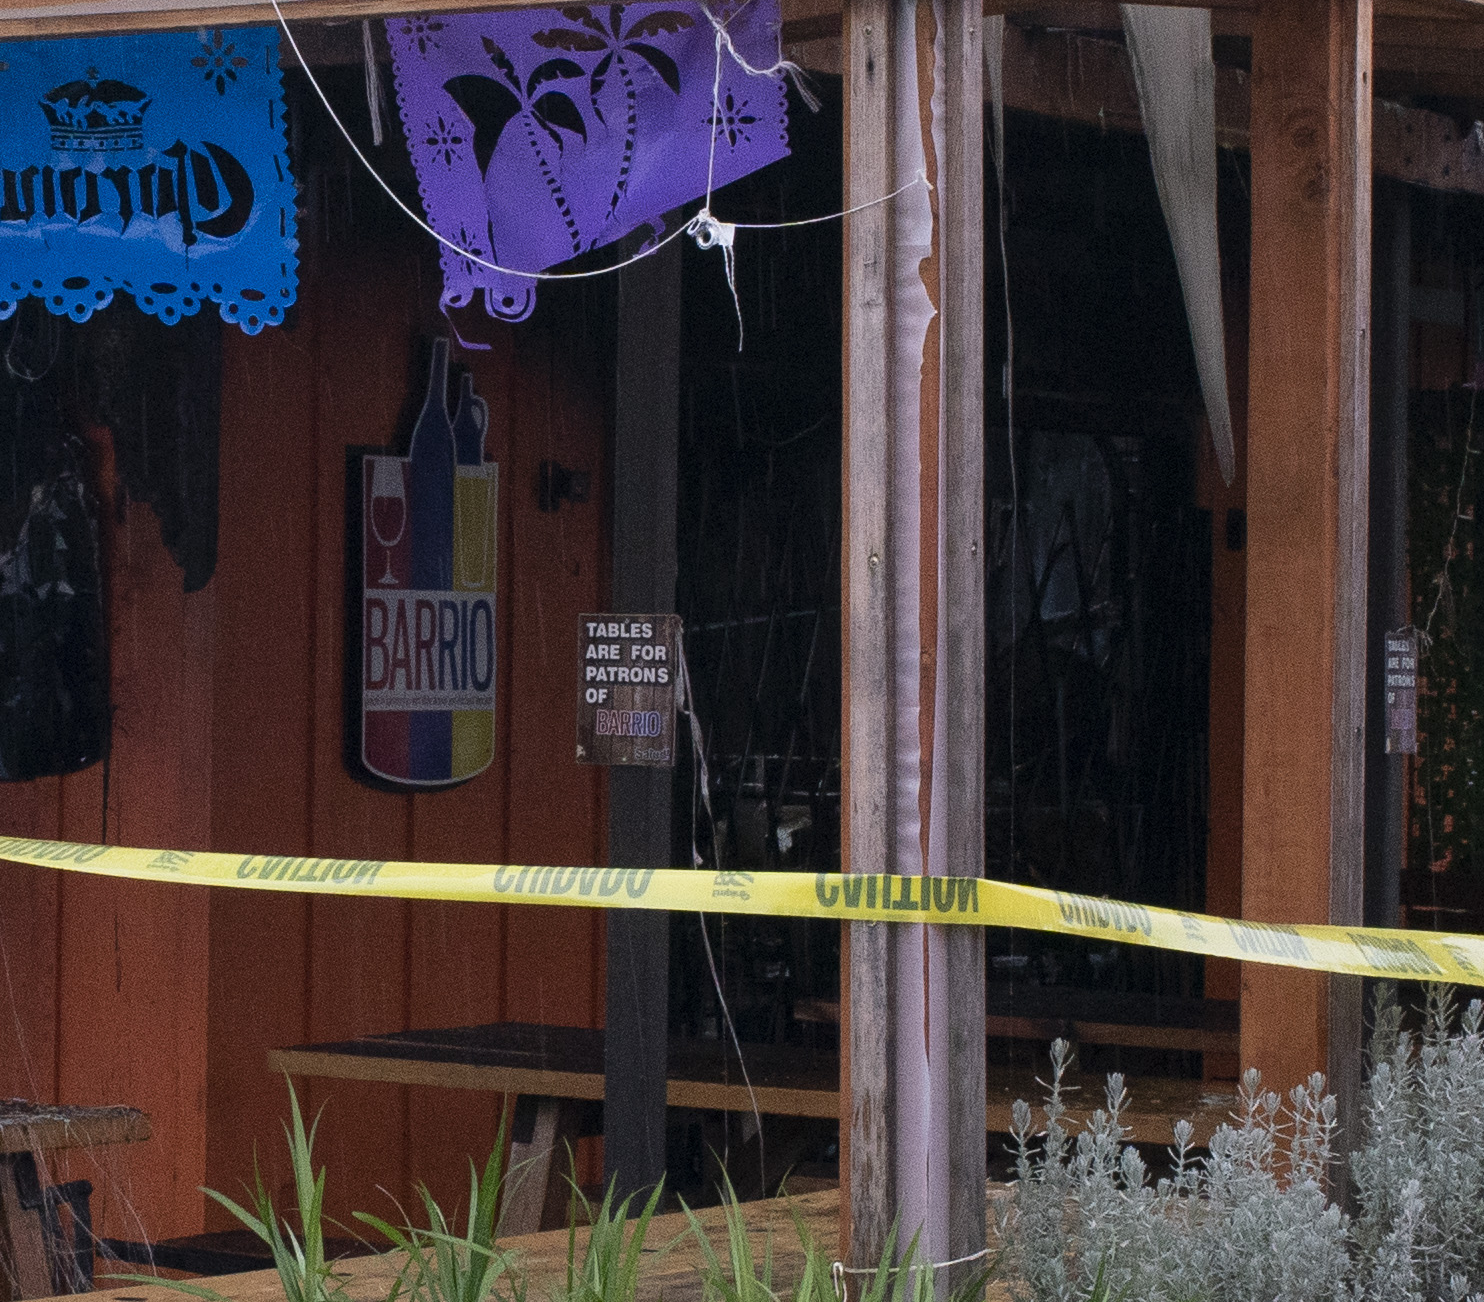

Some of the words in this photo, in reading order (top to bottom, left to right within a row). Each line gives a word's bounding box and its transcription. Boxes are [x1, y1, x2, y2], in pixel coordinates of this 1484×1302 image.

[586, 622, 653, 638] TABLES
[365, 598, 494, 692] BARRIO
[586, 644, 620, 660] ARE
[631, 645, 666, 661] FOR
[586, 666, 669, 683] PATRONS
[585, 688, 608, 704] OF
[596, 709, 662, 737] BARRIO
